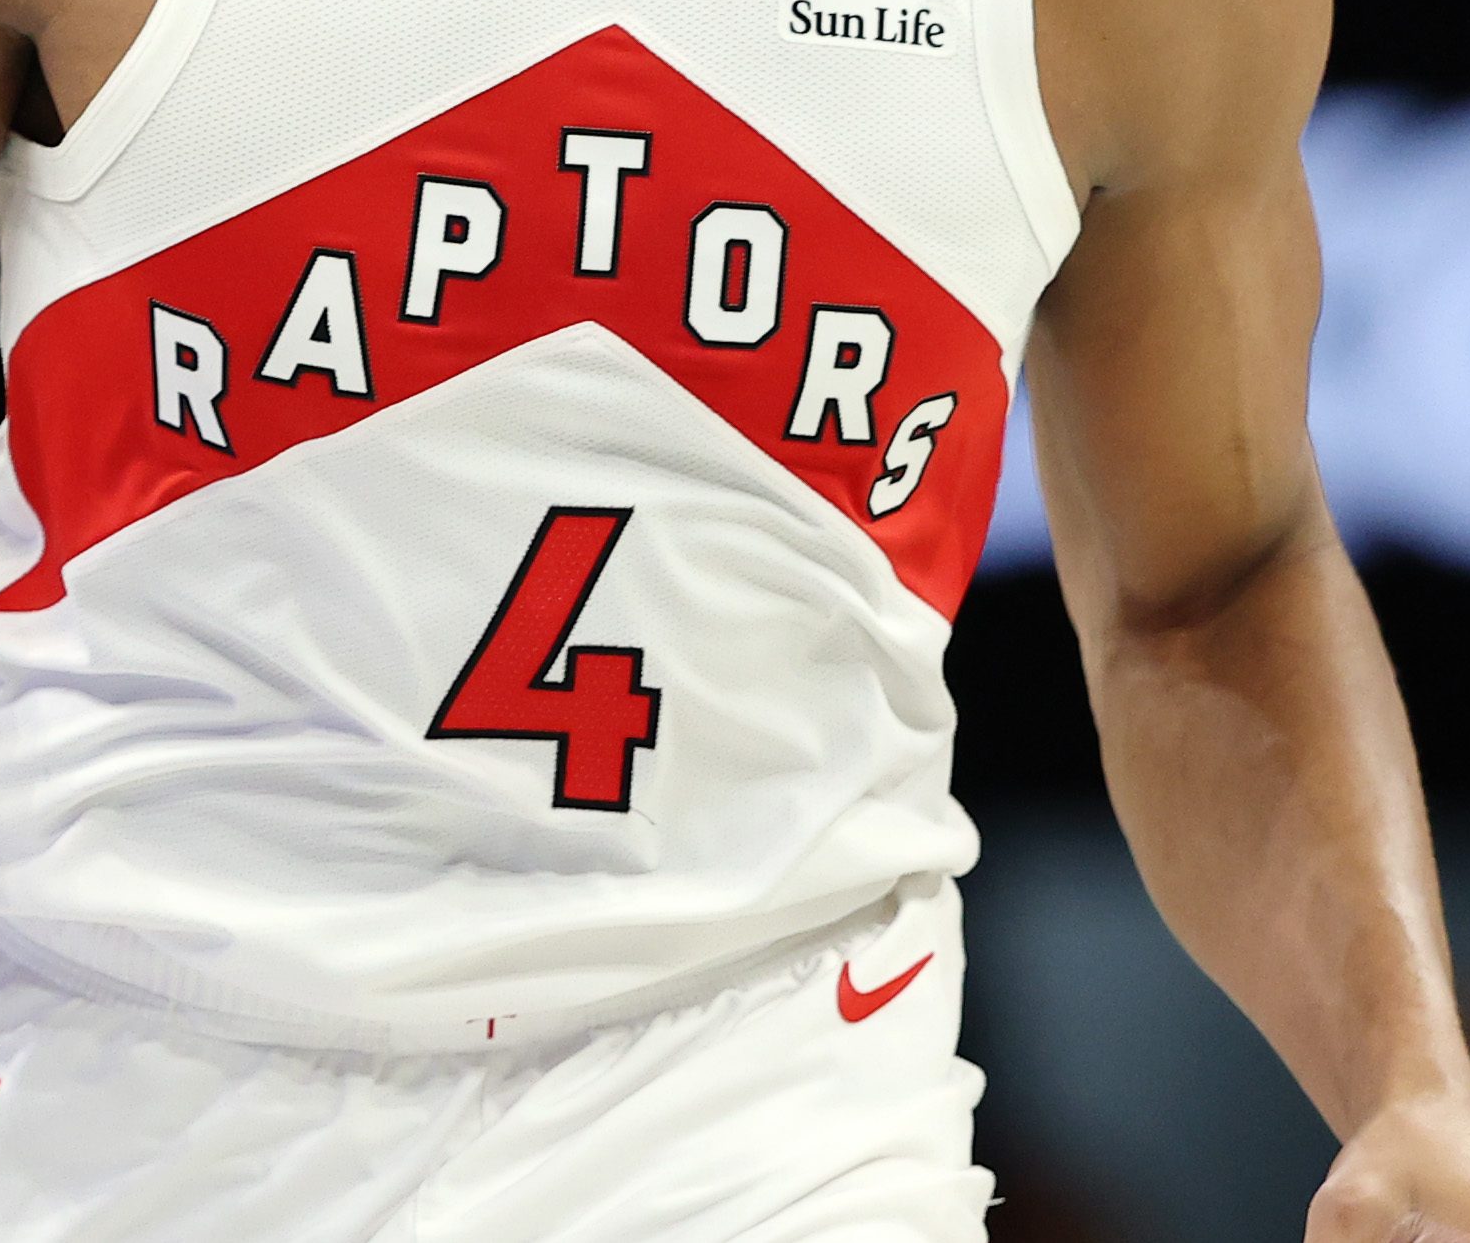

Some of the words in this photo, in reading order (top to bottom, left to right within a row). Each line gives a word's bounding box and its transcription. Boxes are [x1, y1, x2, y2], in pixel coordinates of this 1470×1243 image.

[789, 0, 867, 39] Sun
[874, 7, 946, 48] Life
[149, 125, 958, 520] RAPTORS
[425, 505, 662, 812] 4
